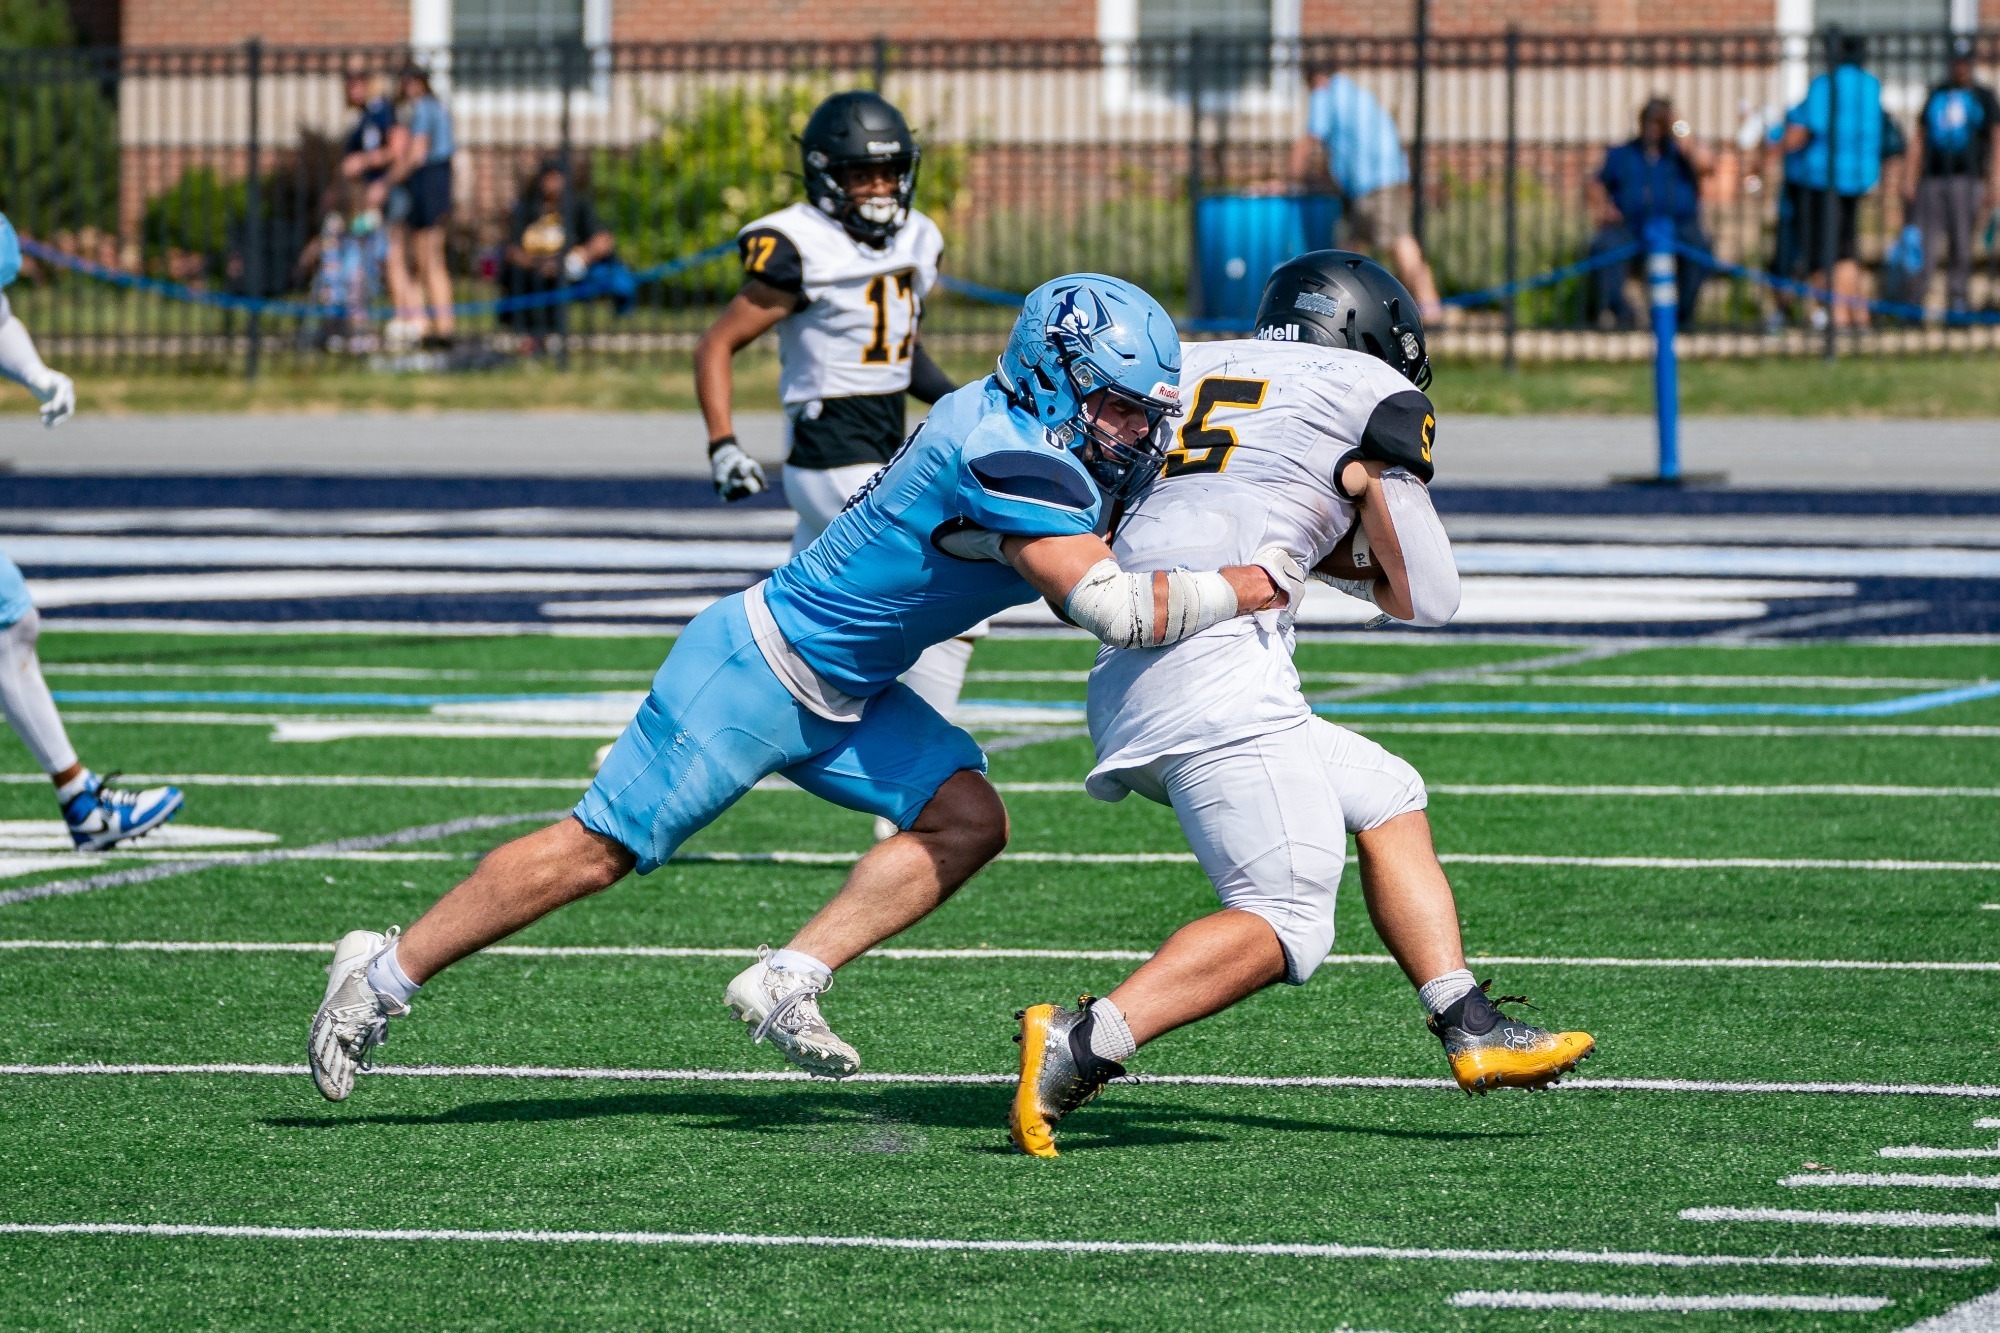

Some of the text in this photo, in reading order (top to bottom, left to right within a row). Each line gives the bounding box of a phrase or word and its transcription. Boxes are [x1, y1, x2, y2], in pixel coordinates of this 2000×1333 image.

[745, 236, 777, 272] 17
[862, 267, 915, 364] 17
[1253, 323, 1300, 341] ddell
[1162, 376, 1270, 478] 5
[1421, 413, 1435, 463] 5
